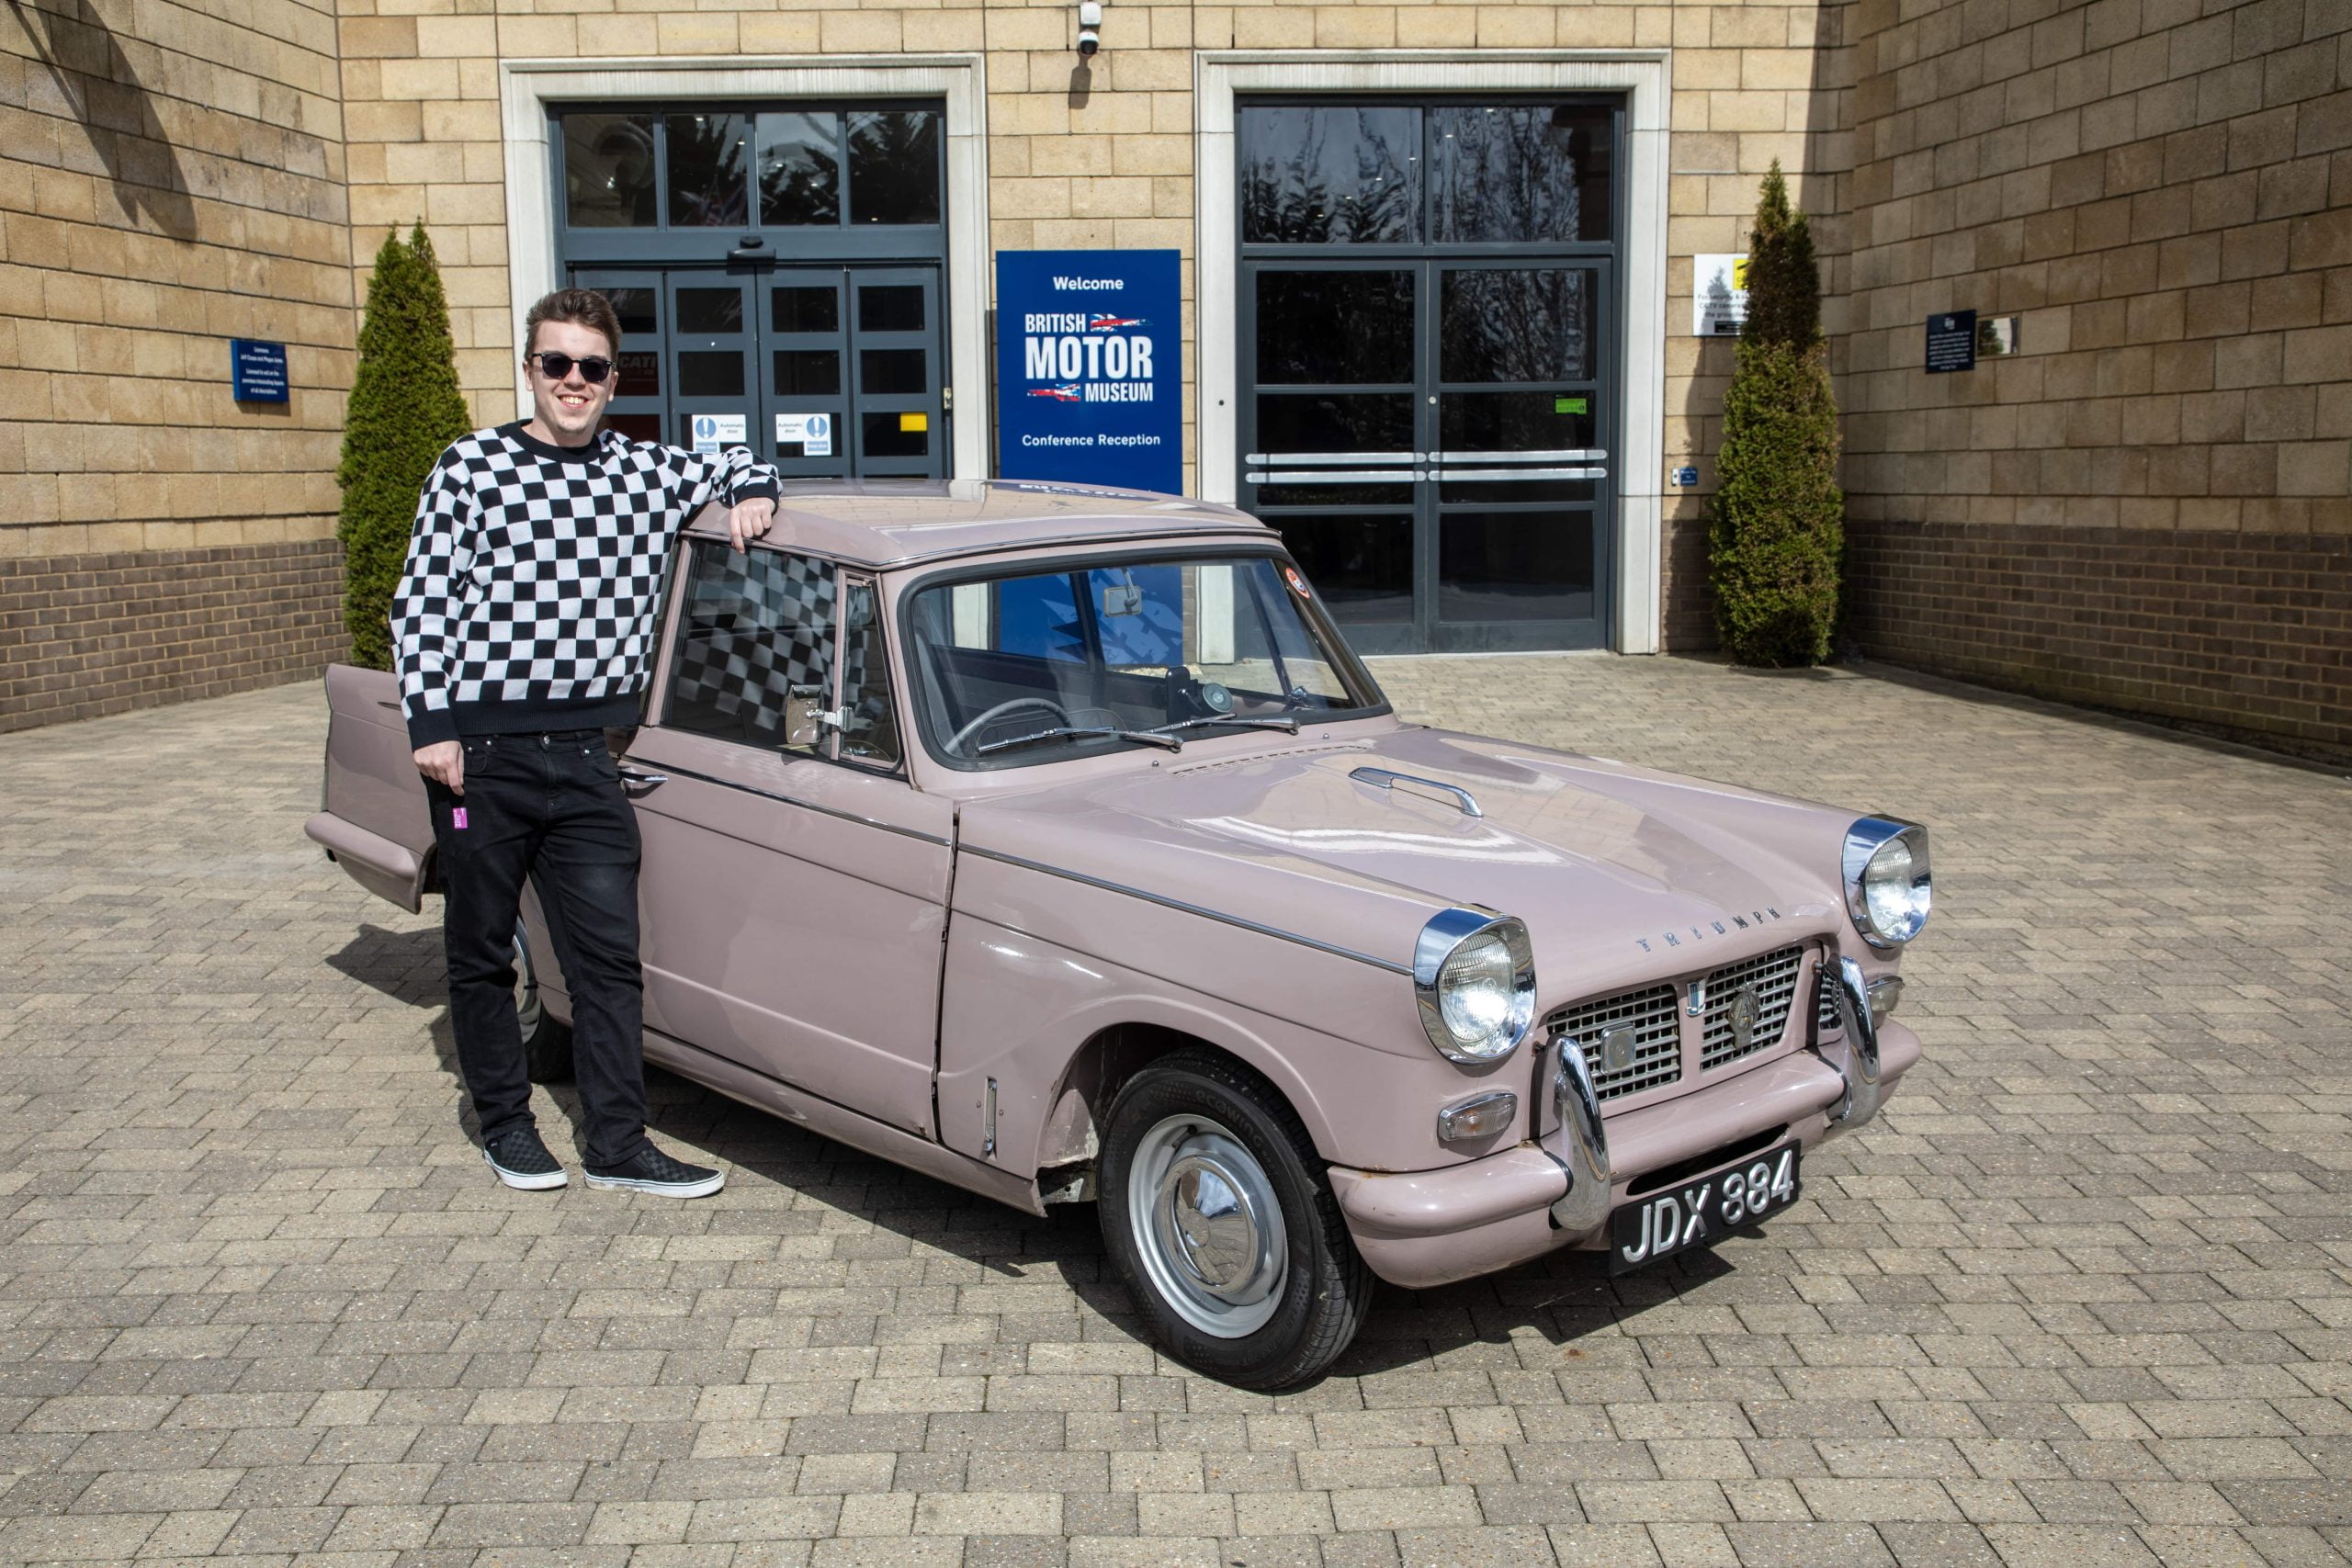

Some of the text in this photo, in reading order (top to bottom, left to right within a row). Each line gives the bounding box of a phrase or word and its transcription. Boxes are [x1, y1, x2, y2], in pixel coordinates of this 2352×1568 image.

[1053, 276, 1124, 290] Welcome
[1025, 313, 1086, 333] BRITISH
[1025, 335, 1153, 379] MOTOR
[1085, 382, 1153, 401] MUSEUM
[1023, 434, 1160, 447] Conference Reception
[1636, 906, 1781, 952] TRIUMPH
[1623, 1149, 1793, 1263] JDX 884
